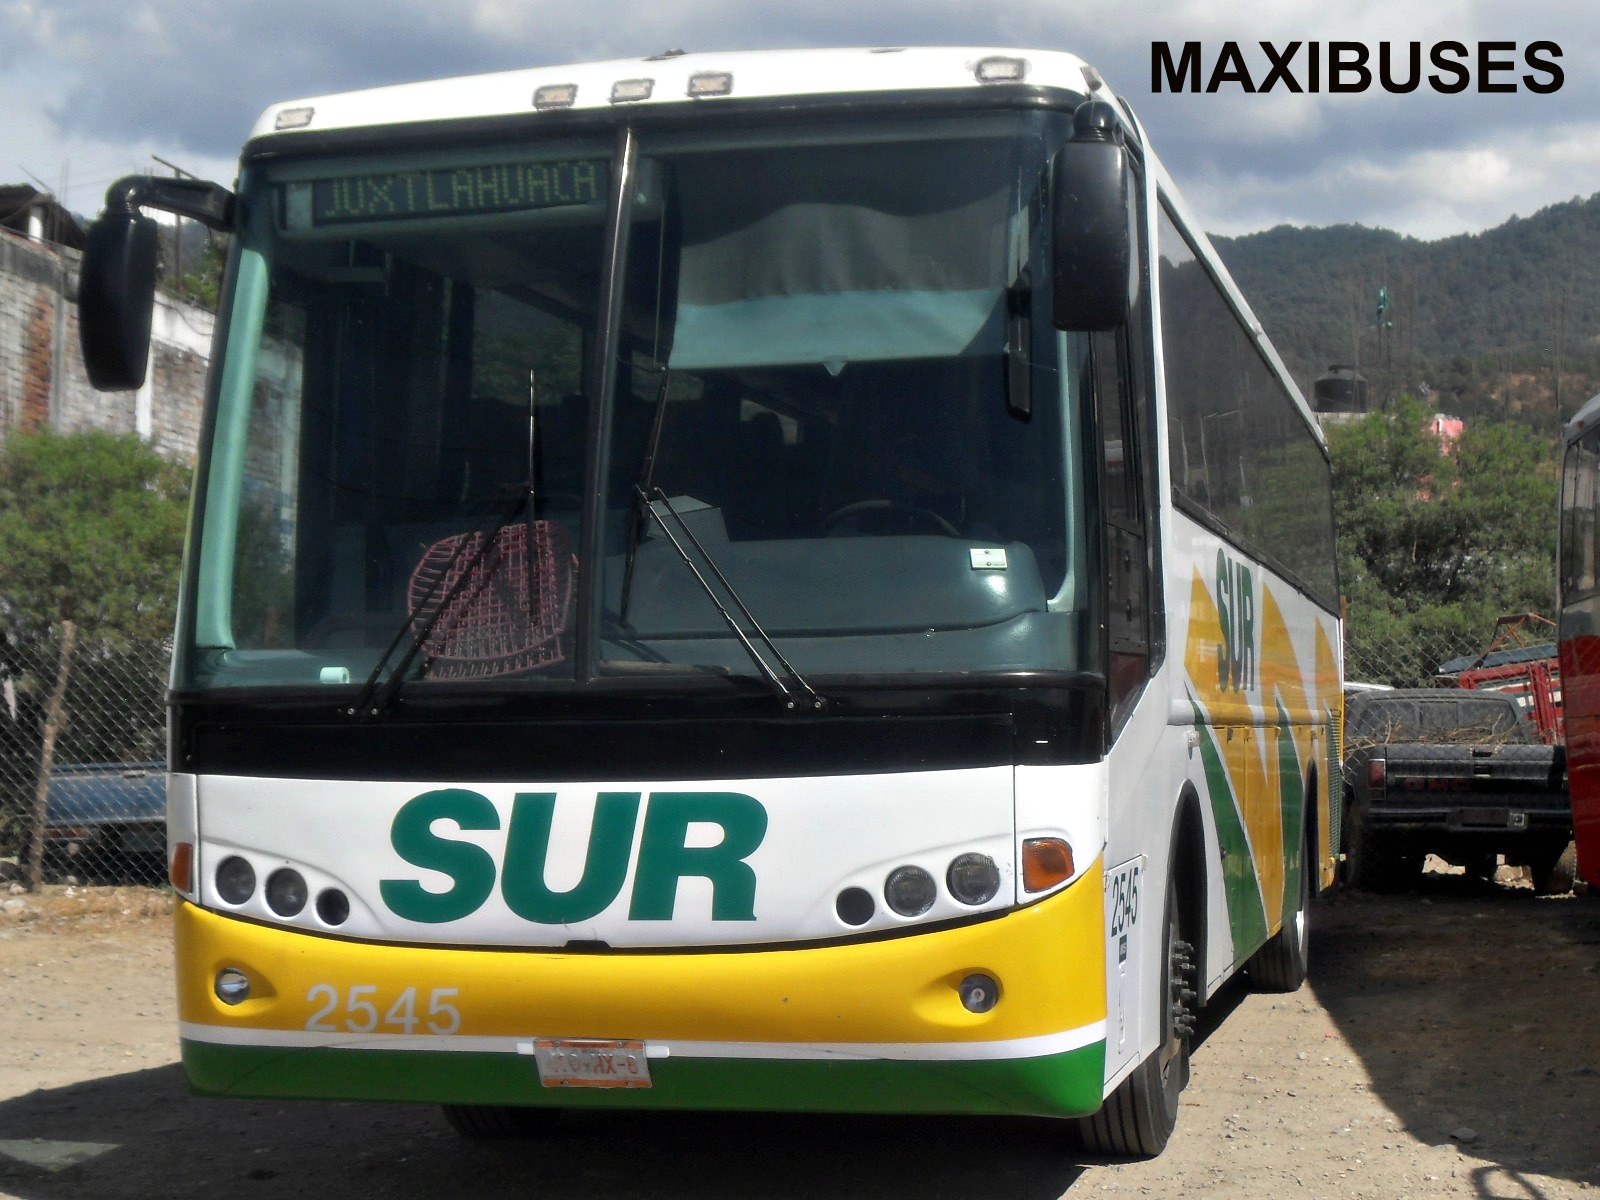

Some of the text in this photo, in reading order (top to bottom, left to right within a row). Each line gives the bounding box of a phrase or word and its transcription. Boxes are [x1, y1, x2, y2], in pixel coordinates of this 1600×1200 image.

[326, 160, 598, 216] JUXTLAHUACA
[1216, 547, 1255, 694] SUR
[379, 788, 768, 924] SUR
[1111, 866, 1139, 938] 2545
[304, 983, 461, 1036] 2545
